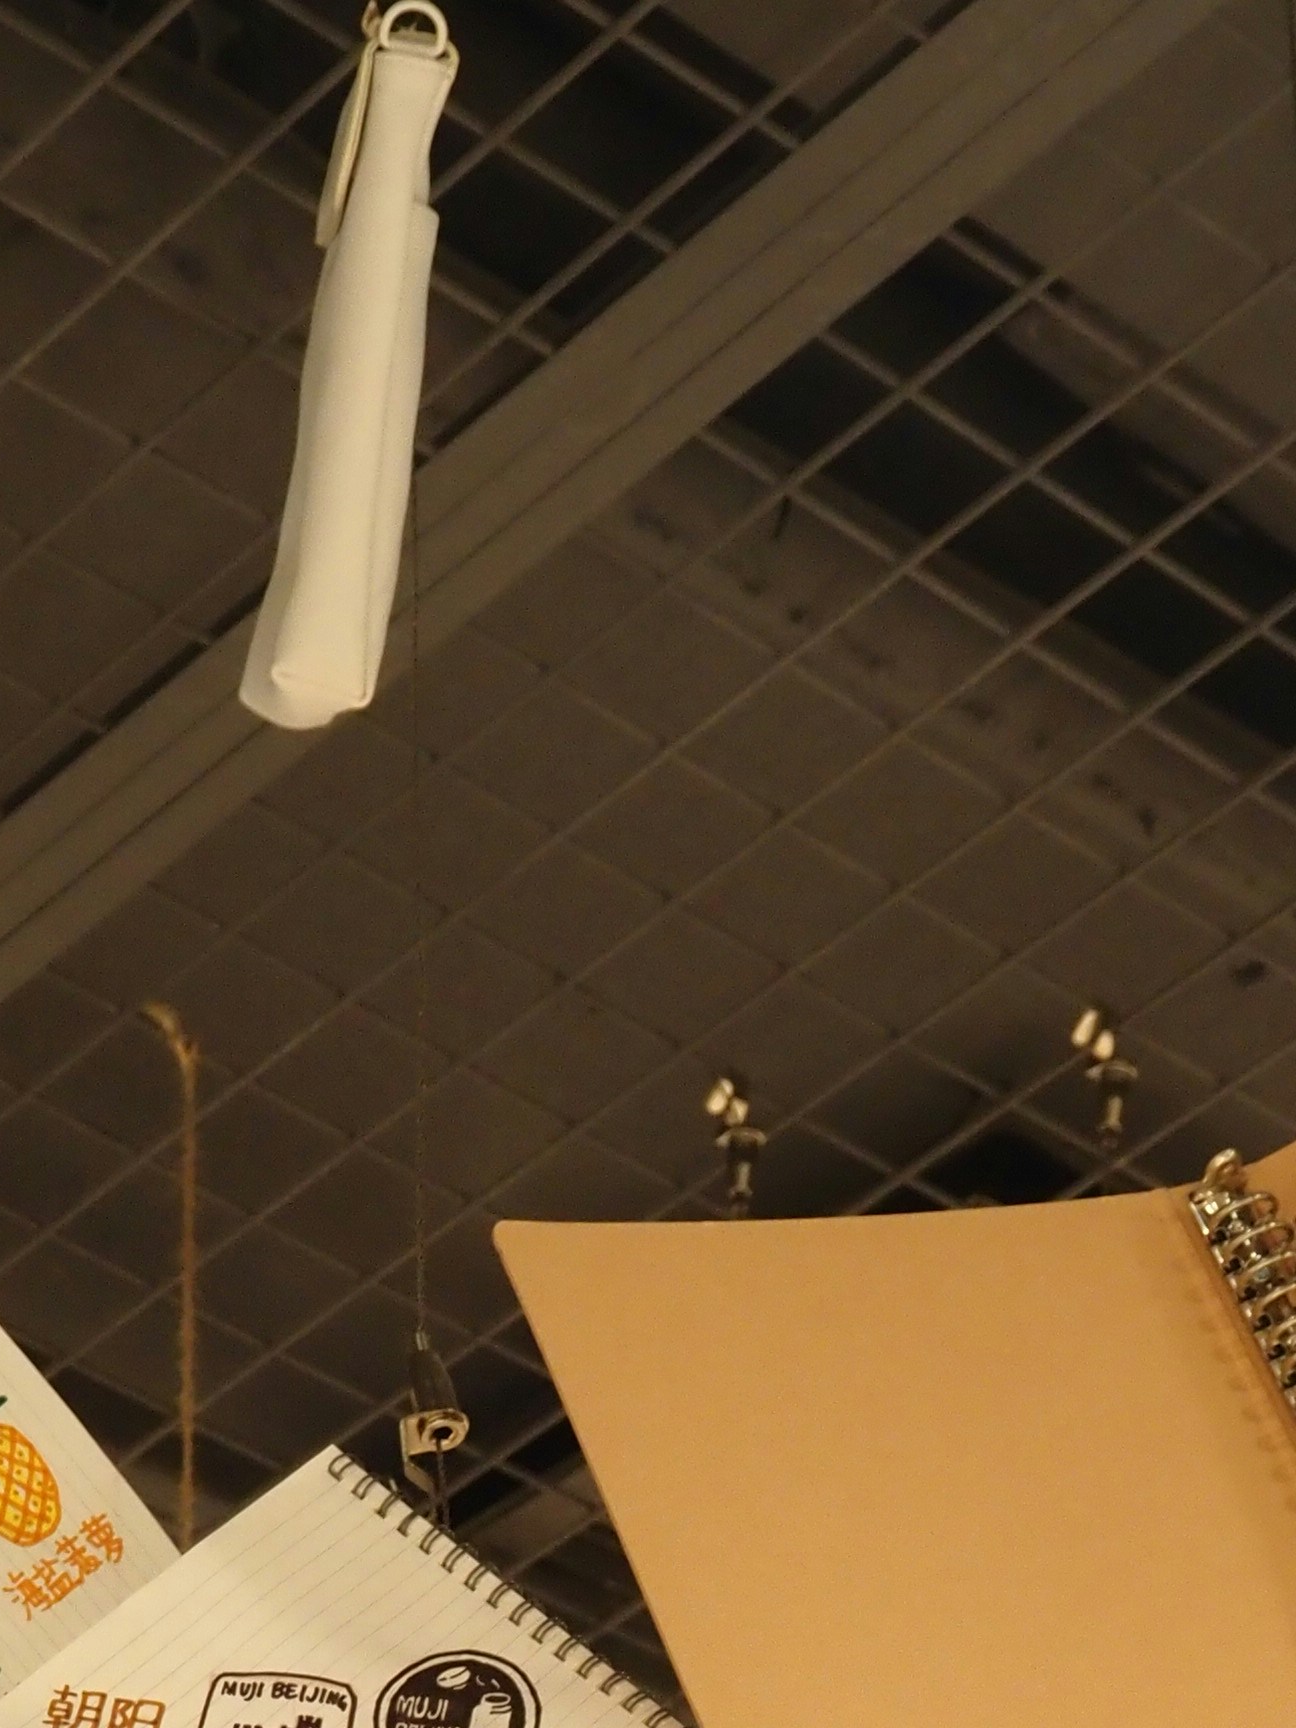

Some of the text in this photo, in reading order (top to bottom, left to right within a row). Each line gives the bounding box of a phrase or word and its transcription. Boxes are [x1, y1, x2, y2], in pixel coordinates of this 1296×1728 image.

[2, 1513, 124, 1621] 海盐菠萝
[220, 1681, 348, 1712] MUJI BEIJING
[396, 1695, 449, 1720] MUJI
